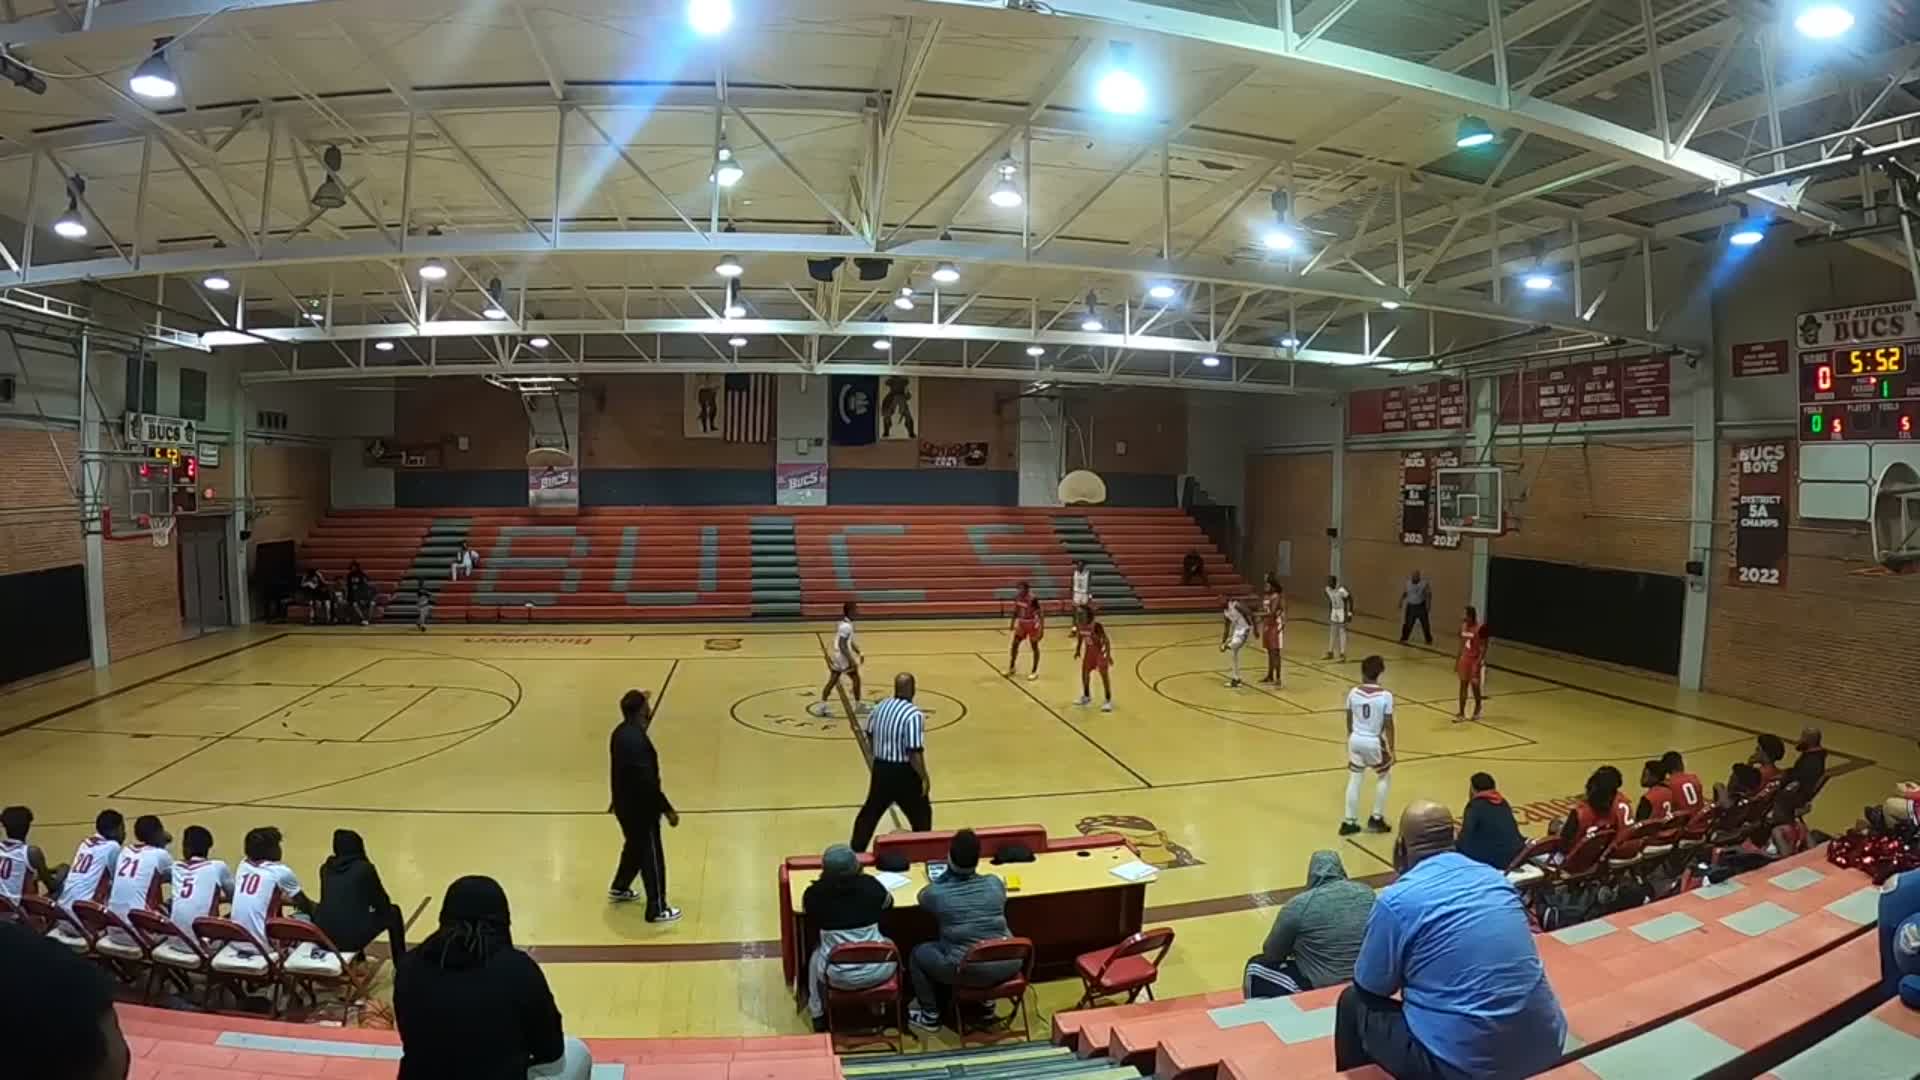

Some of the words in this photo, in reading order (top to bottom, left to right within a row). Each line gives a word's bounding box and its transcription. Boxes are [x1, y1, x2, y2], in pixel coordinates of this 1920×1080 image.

[1834, 315, 1904, 341] BUCS
[1850, 347, 1900, 373] 5:52
[1818, 366, 1831, 389] 0
[1882, 380, 1888, 398] 1
[148, 424, 181, 440] BUCS
[1811, 415, 1822, 432] 0
[1739, 445, 1785, 462] BUCS
[1742, 461, 1779, 473] BOYS
[788, 471, 819, 490] BUCS
[1740, 495, 1781, 504] DISTRICT
[1749, 504, 1769, 518] 5A
[1740, 518, 1779, 528] CHAMPS
[470, 524, 1056, 605] BUCS
[1739, 566, 1780, 584] 2022
[1362, 703, 1371, 720] 0
[1682, 782, 1698, 805] 0
[73, 853, 94, 874] 20
[118, 857, 139, 878] 21
[180, 877, 195, 899] 5
[240, 873, 261, 896] 10
